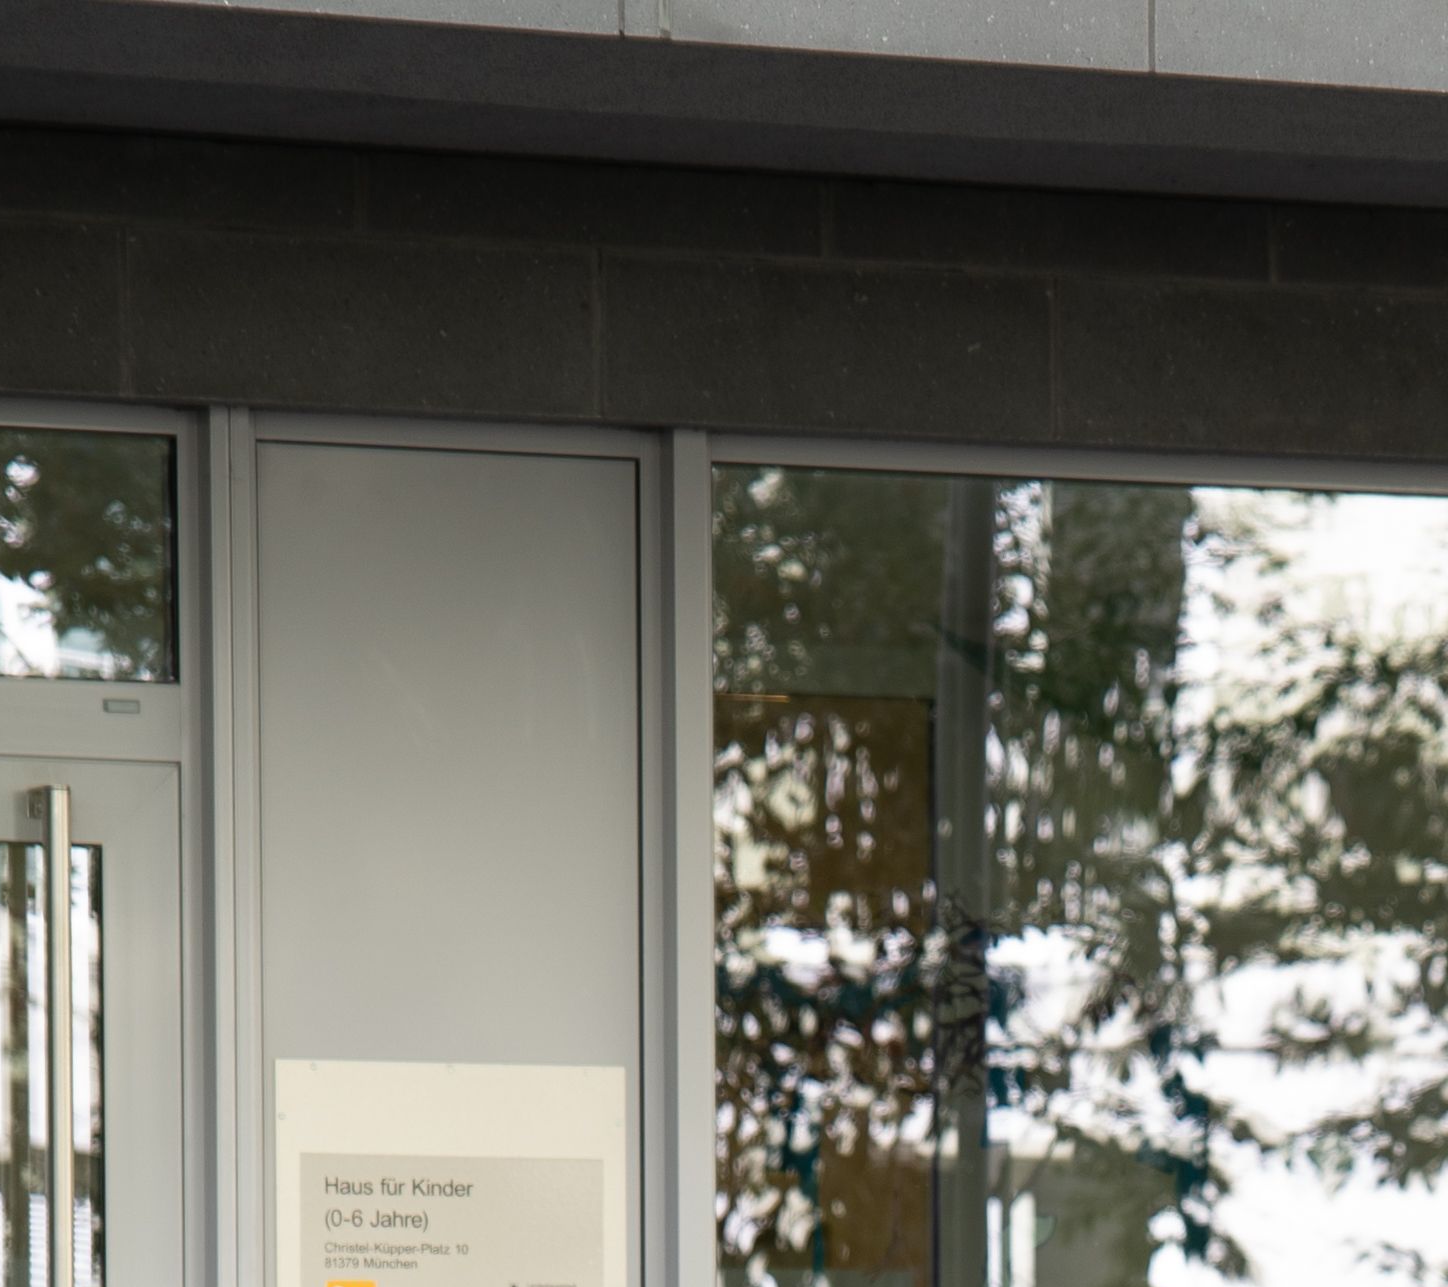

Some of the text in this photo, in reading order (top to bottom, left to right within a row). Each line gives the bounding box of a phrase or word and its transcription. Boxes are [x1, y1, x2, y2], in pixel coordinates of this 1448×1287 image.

[325, 1176, 474, 1198] Haus für Kinder
[325, 1209, 429, 1232] (0-6 Jahre)
[324, 1241, 469, 1256] Christel-Küpper-Platz 10
[324, 1257, 418, 1269] 81379 München
